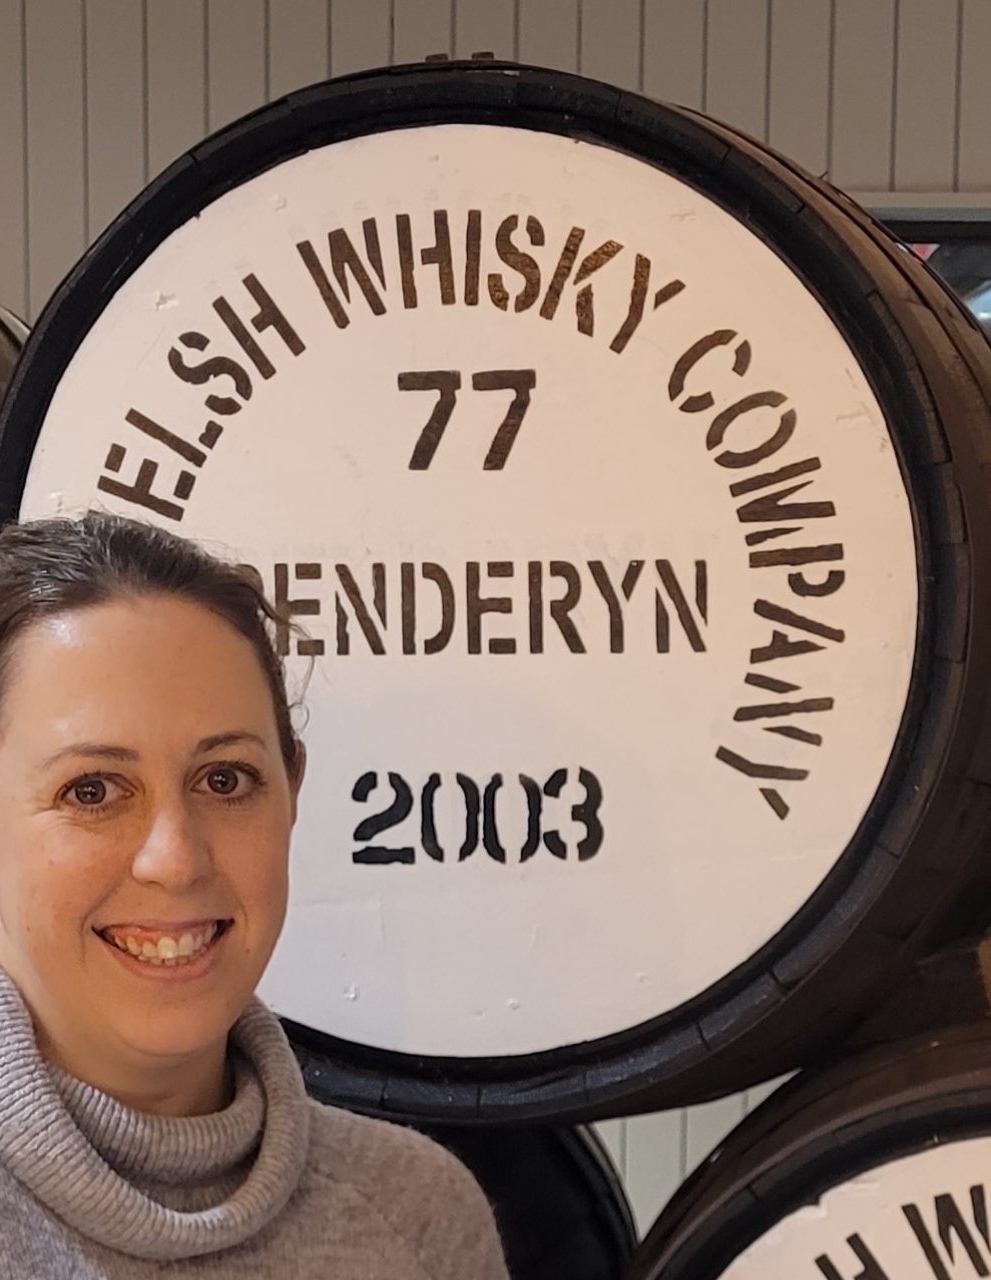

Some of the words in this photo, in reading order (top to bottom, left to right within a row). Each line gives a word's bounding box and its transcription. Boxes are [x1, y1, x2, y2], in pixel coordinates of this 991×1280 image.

[397, 369, 537, 471] 77
[96, 272, 307, 521] ELSH
[296, 208, 685, 355] WHISKY
[667, 328, 845, 820] COMPANY
[236, 561, 709, 656] ENDERYN
[350, 766, 605, 865] 2003
